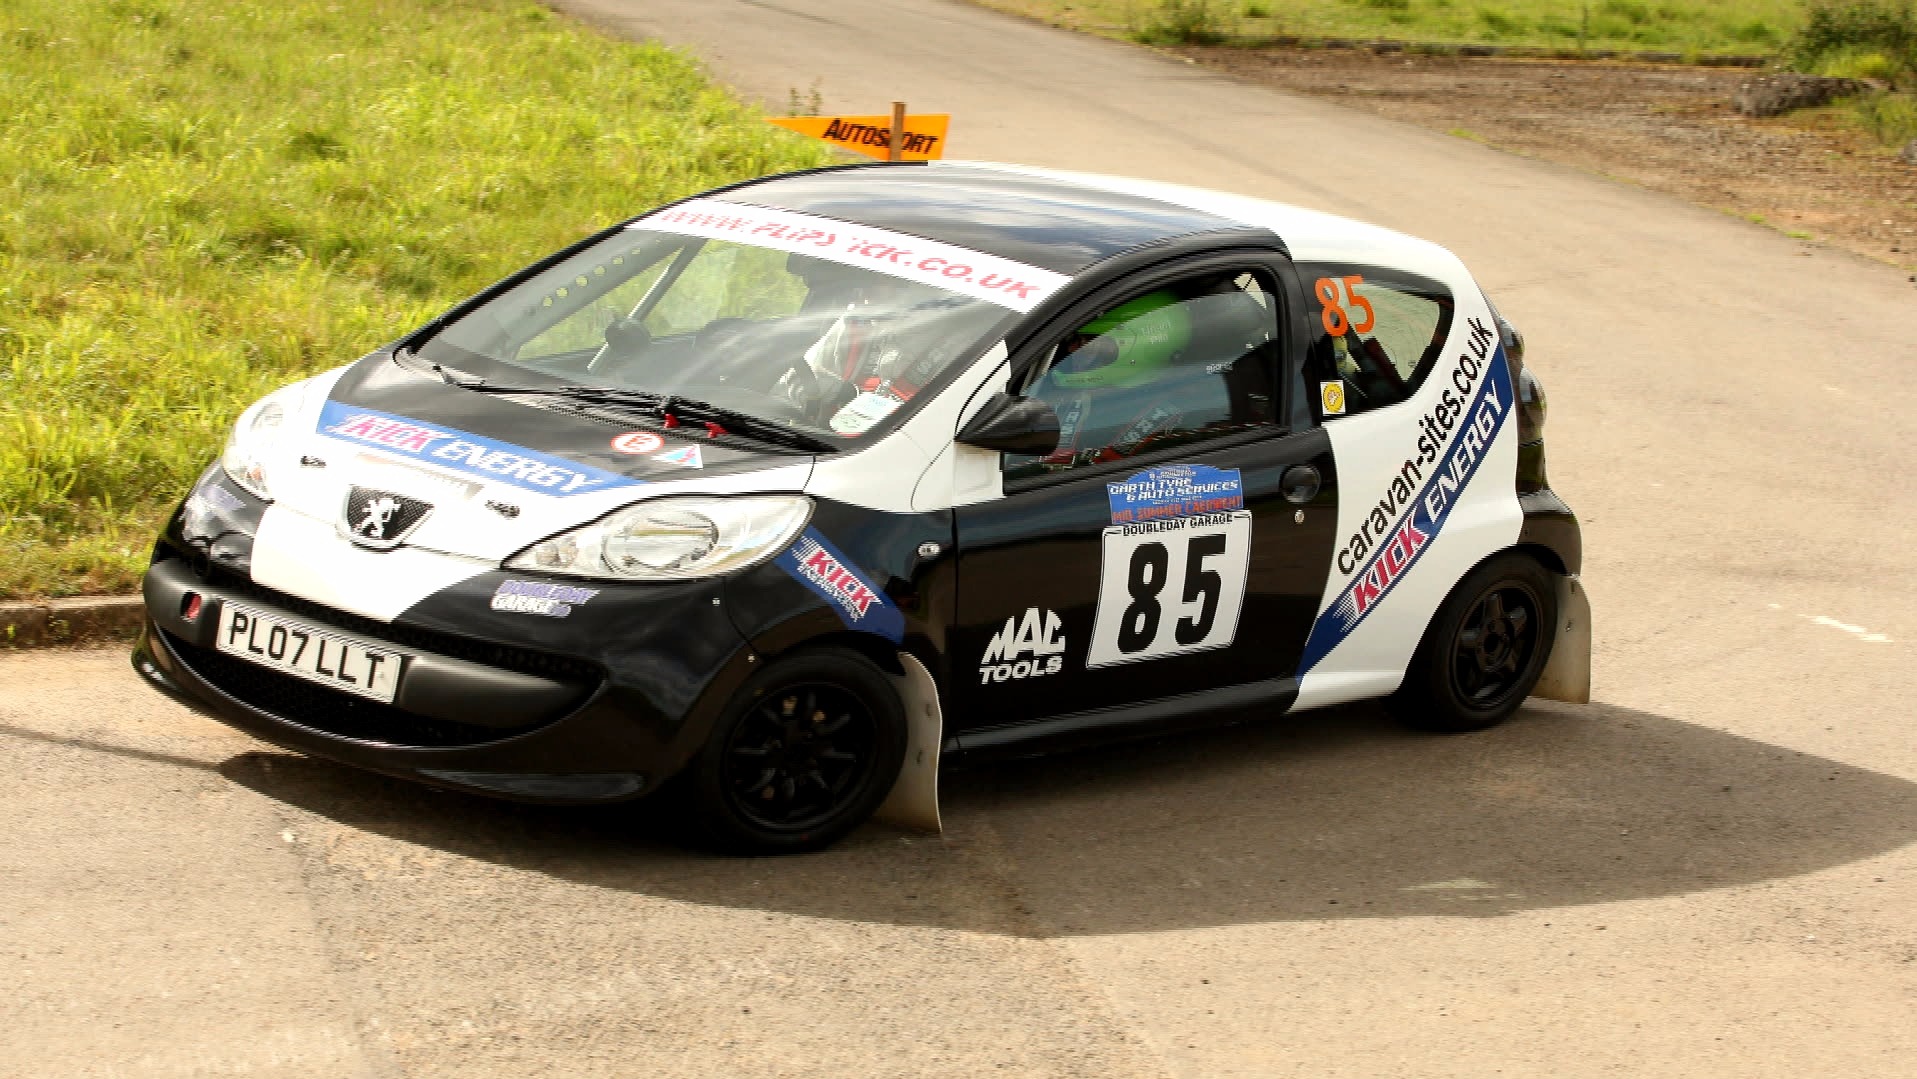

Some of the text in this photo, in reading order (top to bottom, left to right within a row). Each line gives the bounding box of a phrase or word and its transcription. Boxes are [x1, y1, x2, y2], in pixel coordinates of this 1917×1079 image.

[821, 118, 939, 154] AUTOSORT
[1314, 274, 1375, 337] 85
[335, 413, 602, 492] KICK ENERGY
[1338, 316, 1494, 577] caravan-sites.co.uk
[1123, 513, 1233, 536] DOUBLEDAY GARAGE
[1350, 379, 1504, 619] KICK ENERGY
[802, 545, 881, 617] KICK
[1117, 533, 1226, 654] 85
[229, 610, 385, 689] PL07 LLT
[979, 655, 1062, 684] TOOLS
[980, 607, 1065, 665] MAC
